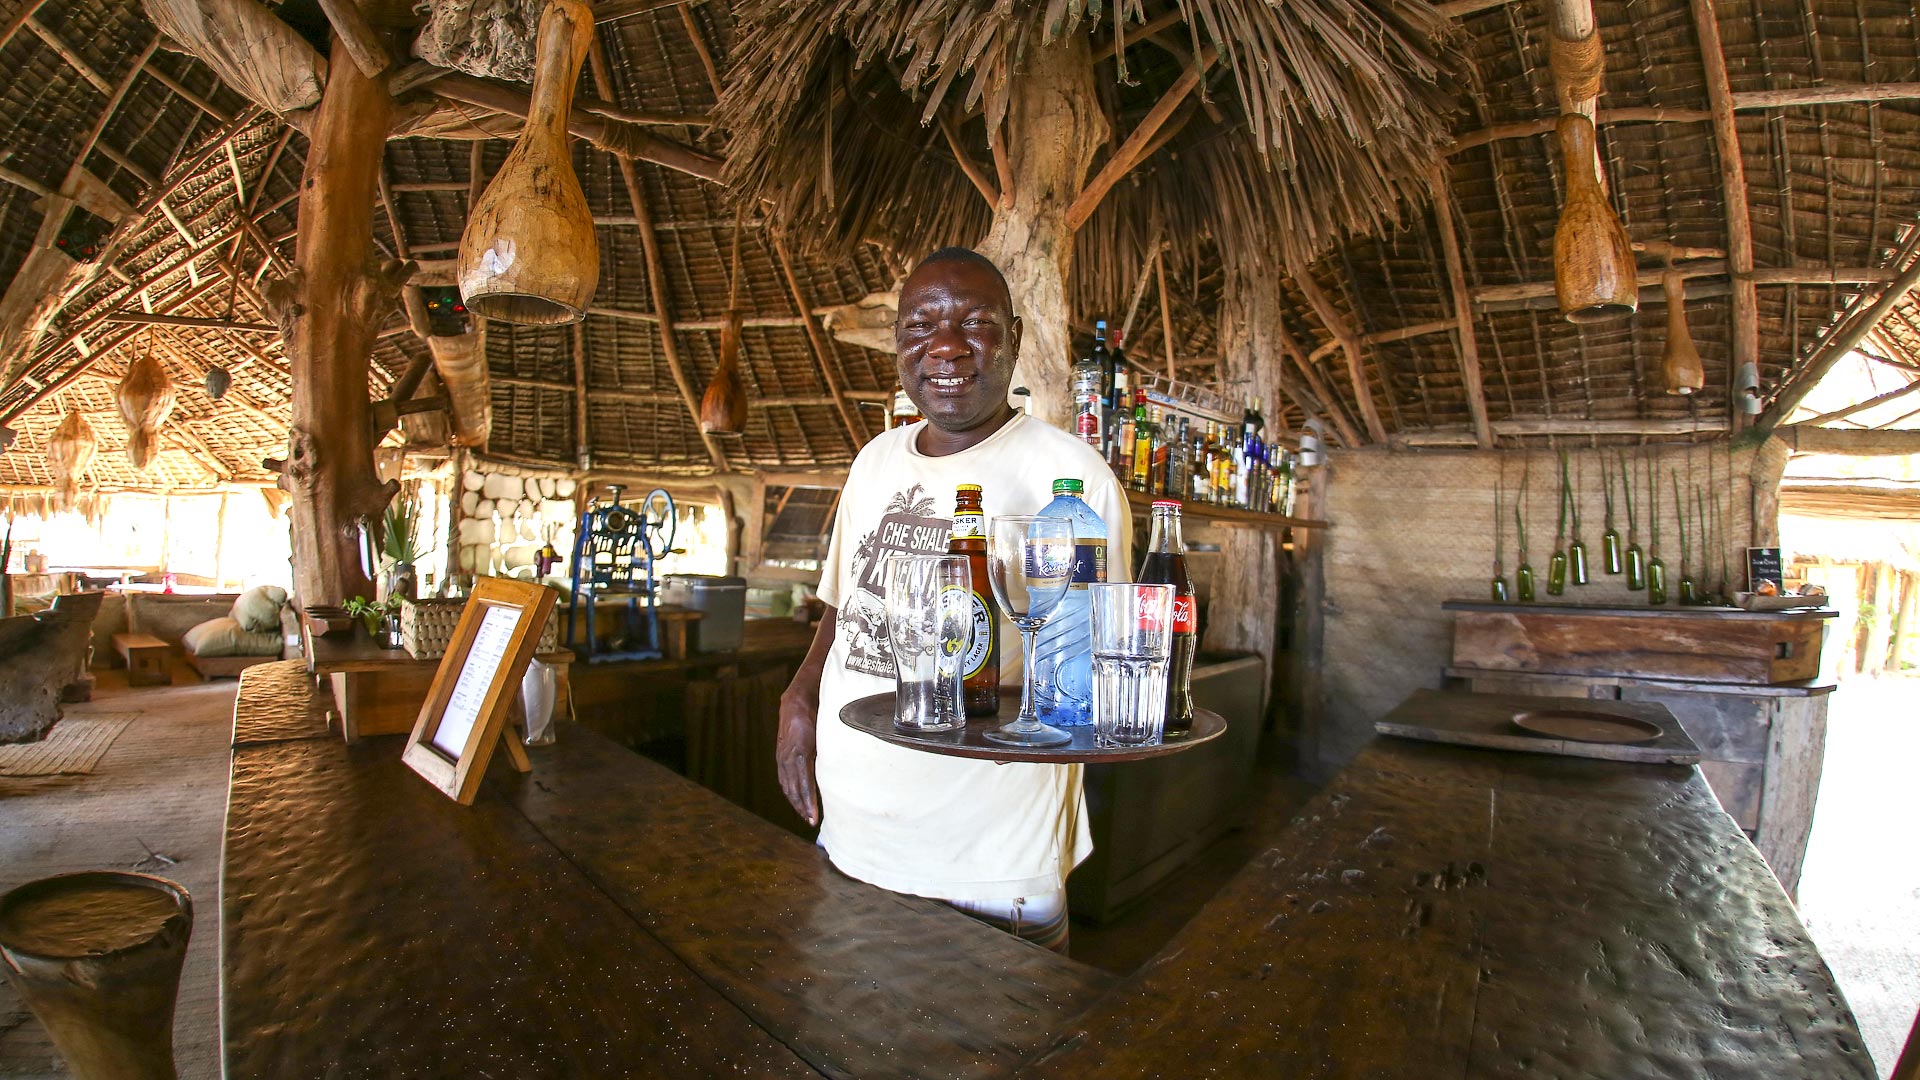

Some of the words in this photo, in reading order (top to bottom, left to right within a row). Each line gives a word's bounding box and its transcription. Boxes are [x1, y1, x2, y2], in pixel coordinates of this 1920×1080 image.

[882, 521, 911, 547] CHE
[910, 525, 953, 554] SHALE
[970, 642, 984, 662] LAGER
